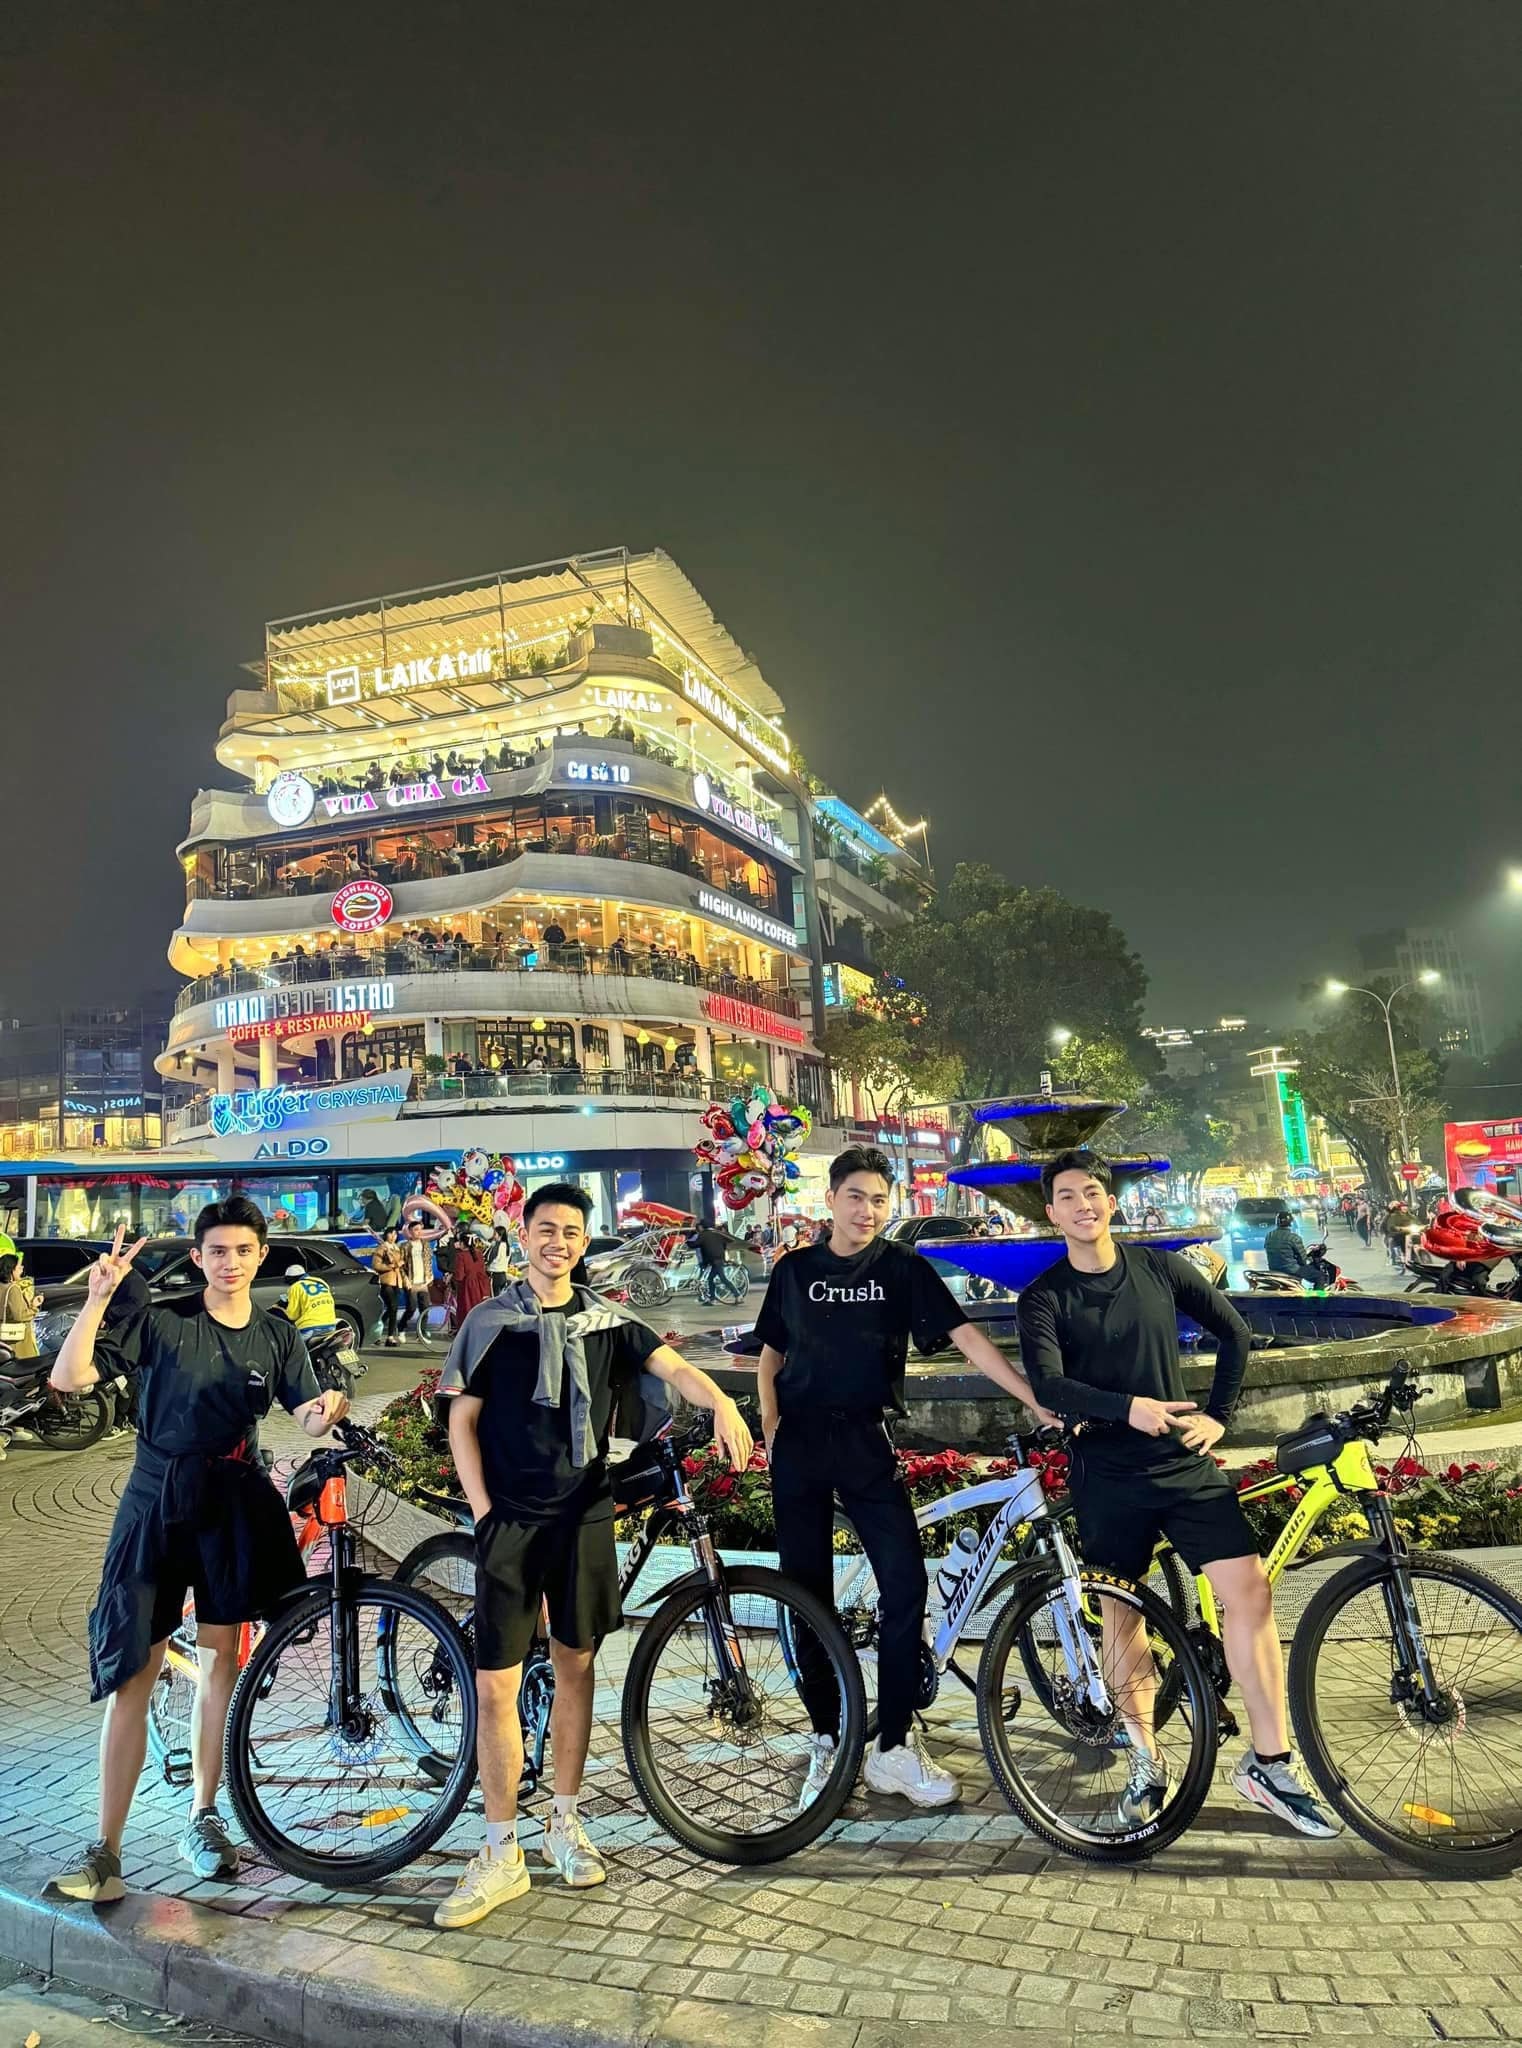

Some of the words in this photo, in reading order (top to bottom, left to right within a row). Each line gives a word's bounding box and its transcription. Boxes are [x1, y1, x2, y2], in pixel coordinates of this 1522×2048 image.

[374, 653, 457, 694] LAIKA
[594, 687, 647, 711] LAIKA
[683, 669, 722, 720] LAIKA
[611, 765, 630, 783] 10
[322, 791, 379, 817] VUA
[710, 793, 736, 825] VUA
[334, 883, 389, 908] HIGHLANDS
[342, 914, 385, 930] COFFEE
[699, 889, 763, 933] HIGHLANDS
[764, 920, 799, 949] COFFEE
[324, 982, 394, 1014] BISTRO
[229, 1022, 271, 1041] COFFEE
[274, 1020, 284, 1035] &
[287, 1011, 371, 1035] RESTAURANT
[236, 1084, 312, 1130] Tiger
[318, 1084, 407, 1110] CRYSTAL
[254, 1136, 330, 1160] ALDO
[513, 1156, 565, 1170] ALDO
[808, 1279, 886, 1303] Crush
[618, 1519, 649, 1593] ERGY
[1080, 1572, 1137, 1593] AXXSI
